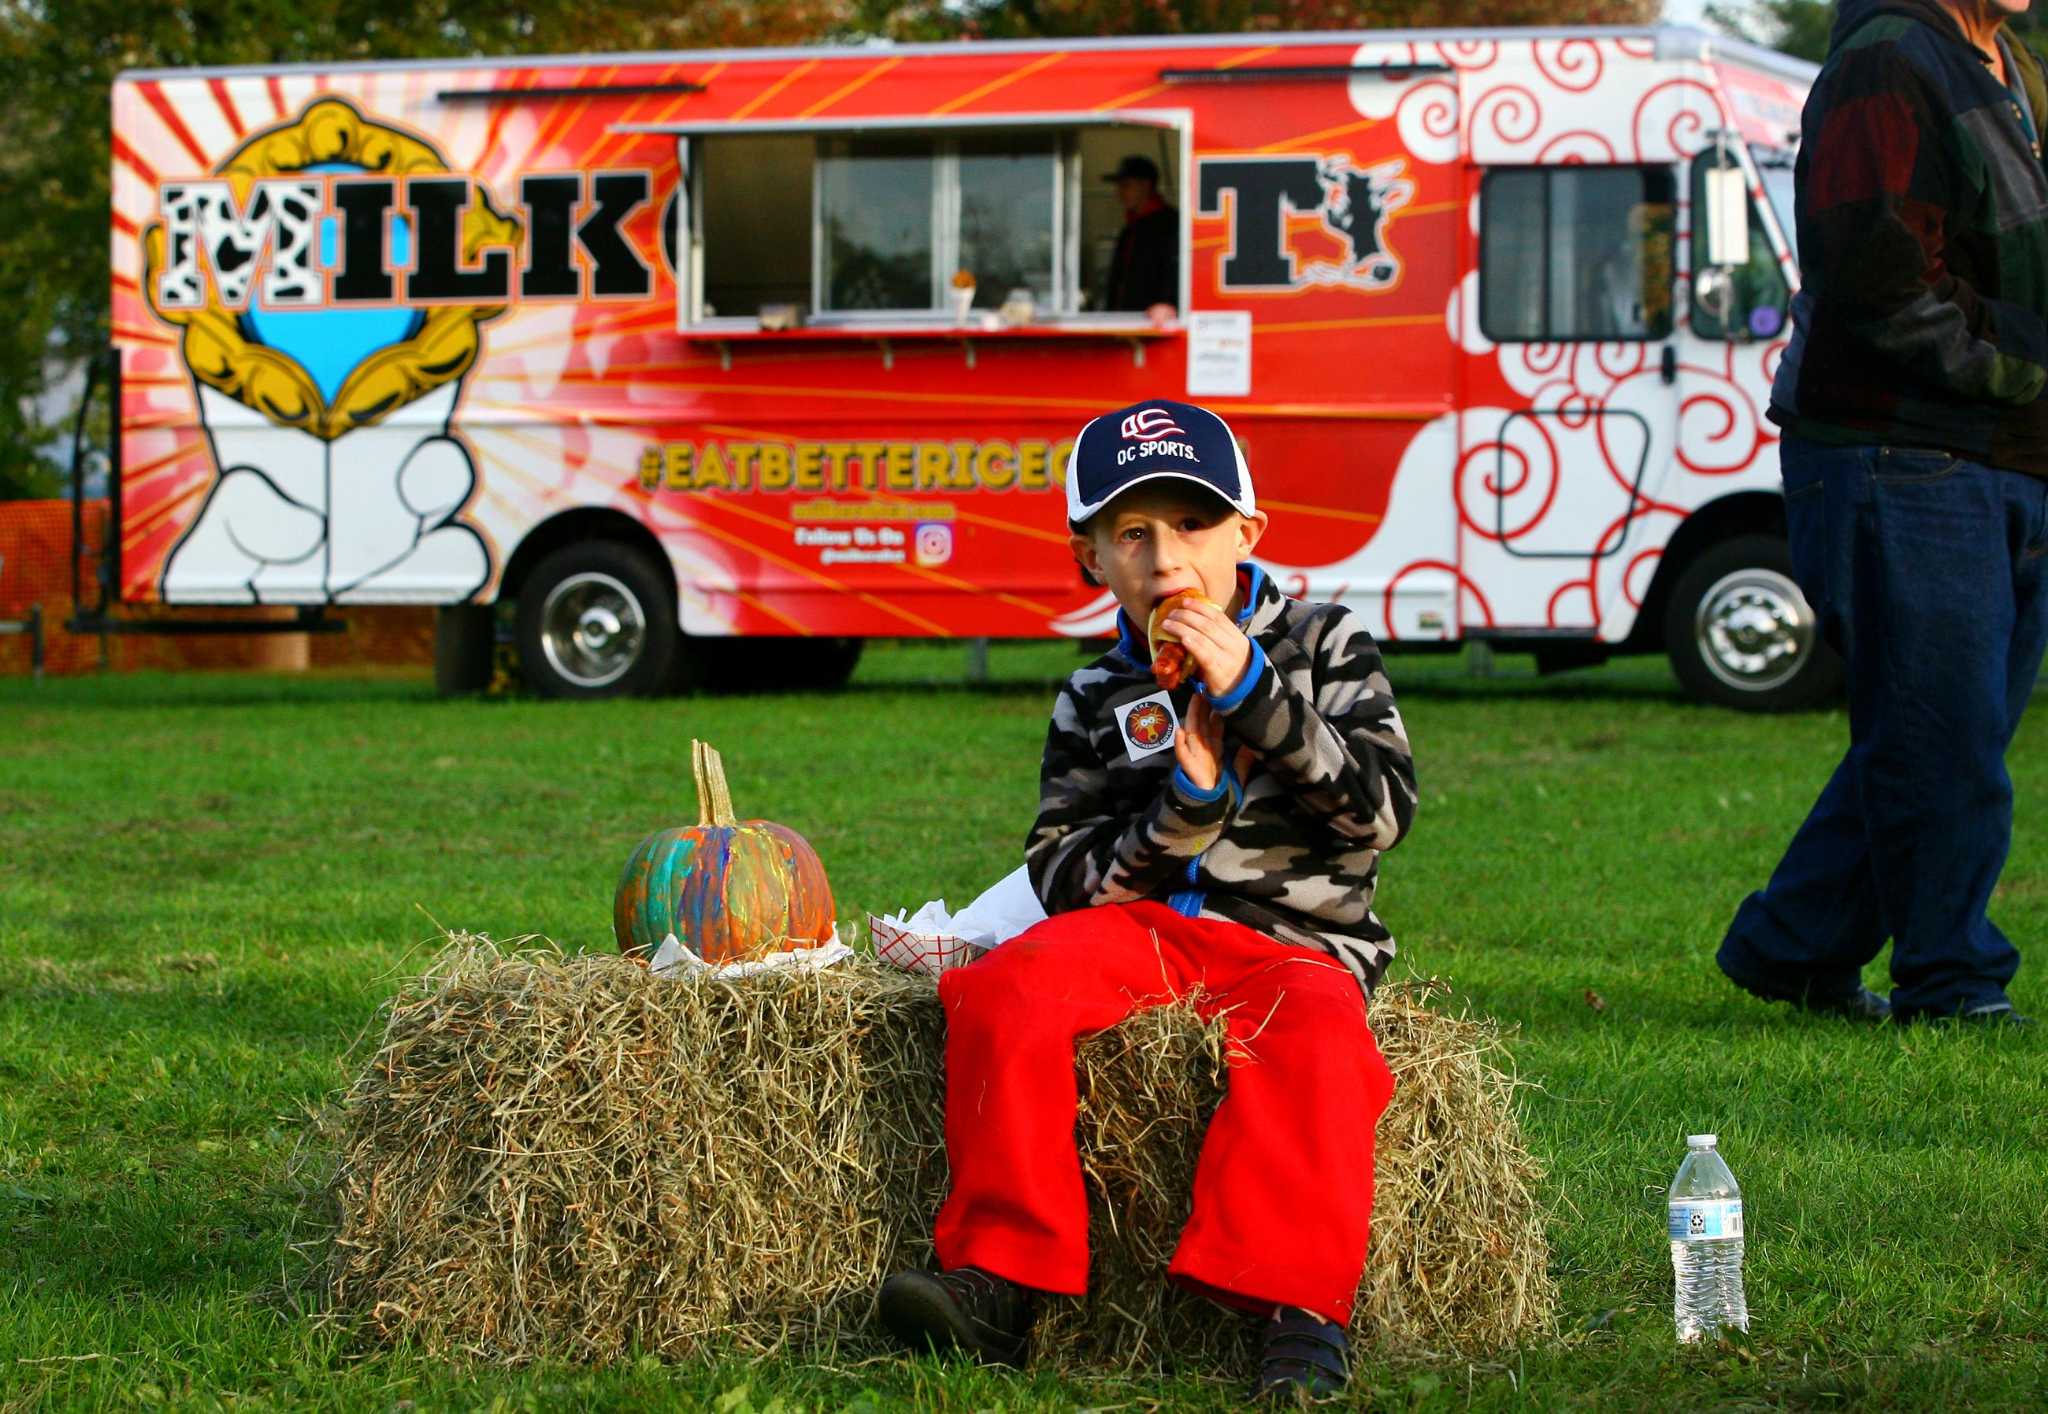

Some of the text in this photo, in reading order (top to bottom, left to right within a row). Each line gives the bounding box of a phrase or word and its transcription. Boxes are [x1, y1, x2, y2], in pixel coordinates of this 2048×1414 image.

[157, 172, 677, 307] MILK
[1117, 441, 1194, 466] OC SPORTS
